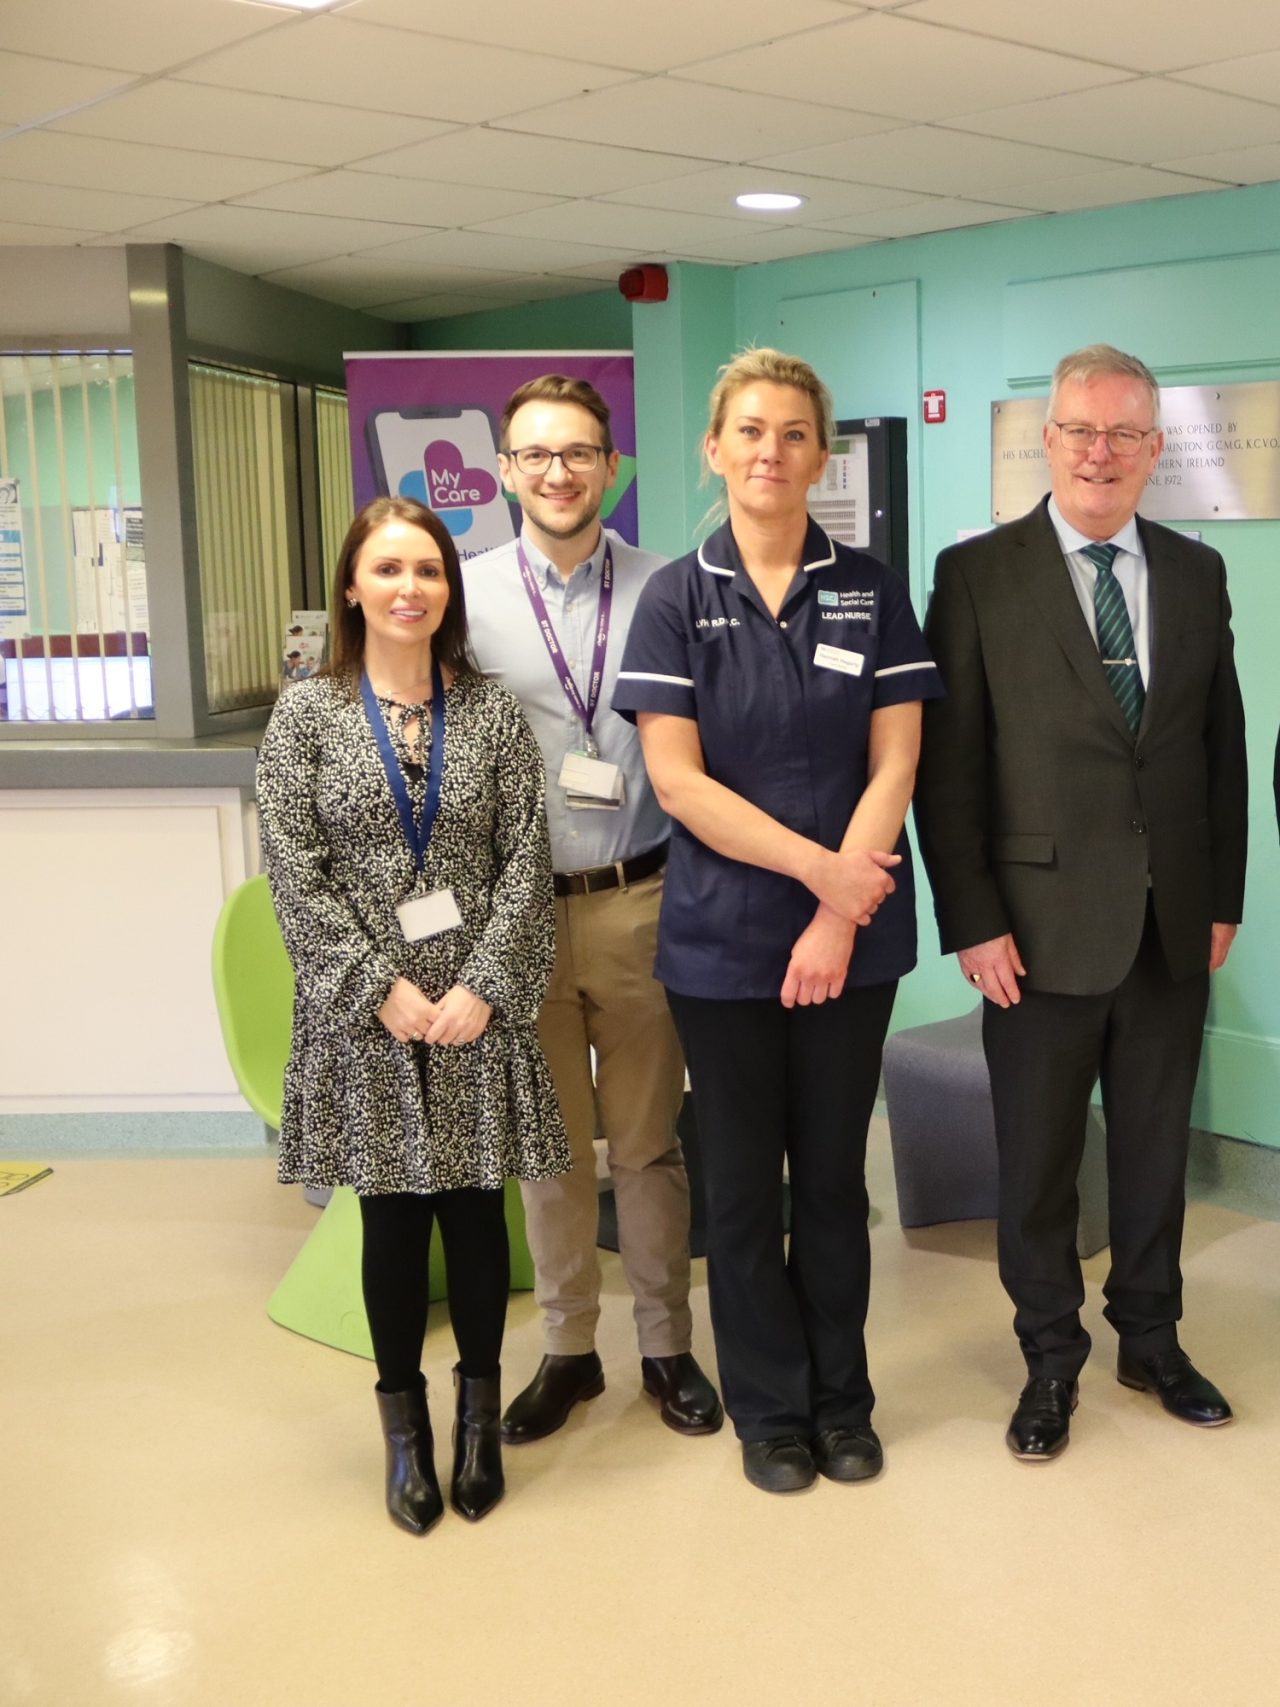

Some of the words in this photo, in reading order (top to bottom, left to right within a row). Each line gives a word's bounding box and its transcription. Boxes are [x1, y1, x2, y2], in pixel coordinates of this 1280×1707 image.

[1166, 425, 1182, 435] WAS
[1187, 423, 1222, 434] OPENED
[1228, 422, 1238, 432] BY
[1003, 450, 1015, 459] HIS
[1187, 457, 1225, 468] IRELAND
[431, 469, 460, 489] My
[1165, 475, 1182, 485] 1972
[434, 486, 481, 504] Care
[840, 590, 860, 598] Health
[821, 612, 844, 620] LEAD
[845, 611, 872, 620] NURSE
